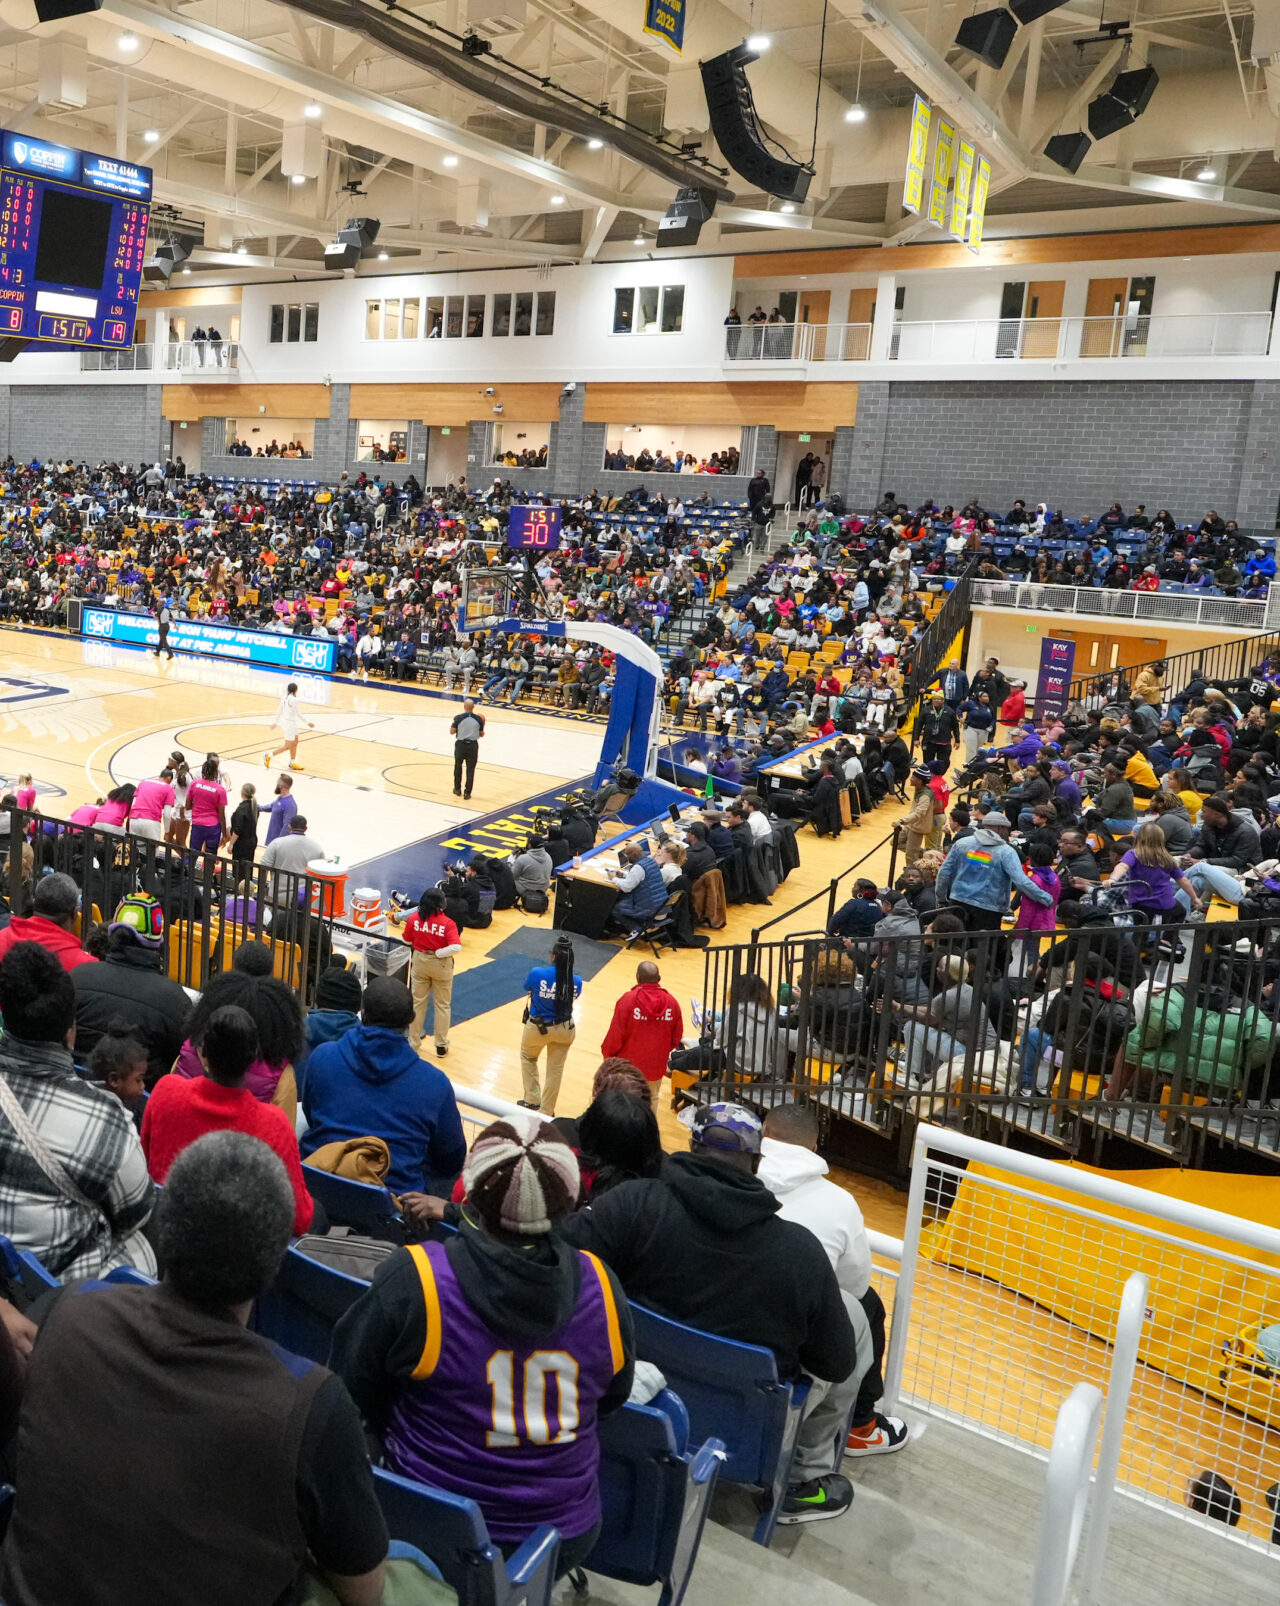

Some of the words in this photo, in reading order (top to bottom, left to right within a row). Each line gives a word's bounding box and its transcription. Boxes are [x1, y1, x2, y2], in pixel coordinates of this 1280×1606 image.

[656, 8, 675, 32] 2022
[98, 160, 118, 173] TEXT
[16, 186, 21, 196] 0
[28, 189, 34, 200] 0
[6, 198, 12, 208] 5
[14, 198, 20, 210] 0
[26, 202, 32, 212] 0
[2, 210, 10, 222] 10
[12, 212, 18, 222] 0
[25, 214, 30, 226] 0
[132, 212, 137, 222] 0
[142, 214, 148, 224] 0
[0, 224, 8, 234] 13
[130, 224, 136, 234] 2
[140, 226, 146, 236] 6
[22, 241, 28, 250] 4
[128, 236, 134, 246] 0
[118, 247, 125, 256] 12
[127, 248, 132, 258] 0
[138, 250, 142, 260] 0
[114, 258, 124, 268] 24
[136, 262, 142, 272] 3
[2, 268, 8, 280] 4
[16, 269, 22, 283] 3
[0, 289, 24, 302] COPPIN
[118, 287, 124, 300] 2
[129, 289, 136, 300] 4
[110, 305, 124, 316] LSU
[10, 310, 20, 328] 8
[112, 324, 124, 339] 19
[530, 511, 556, 523] 1:51
[523, 522, 549, 545] 30
[117, 616, 160, 630] WELCOM
[178, 624, 202, 636] RON
[236, 632, 288, 648] MITCHELL
[520, 622, 548, 631] SPALDING
[179, 638, 194, 648] AT
[214, 643, 250, 658] ARENA
[1052, 643, 1068, 652] KAY
[1048, 676, 1063, 684] KAY
[1250, 683, 1268, 697] 05
[413, 920, 446, 938] S.A.F.E
[486, 1350, 579, 1448] 10
